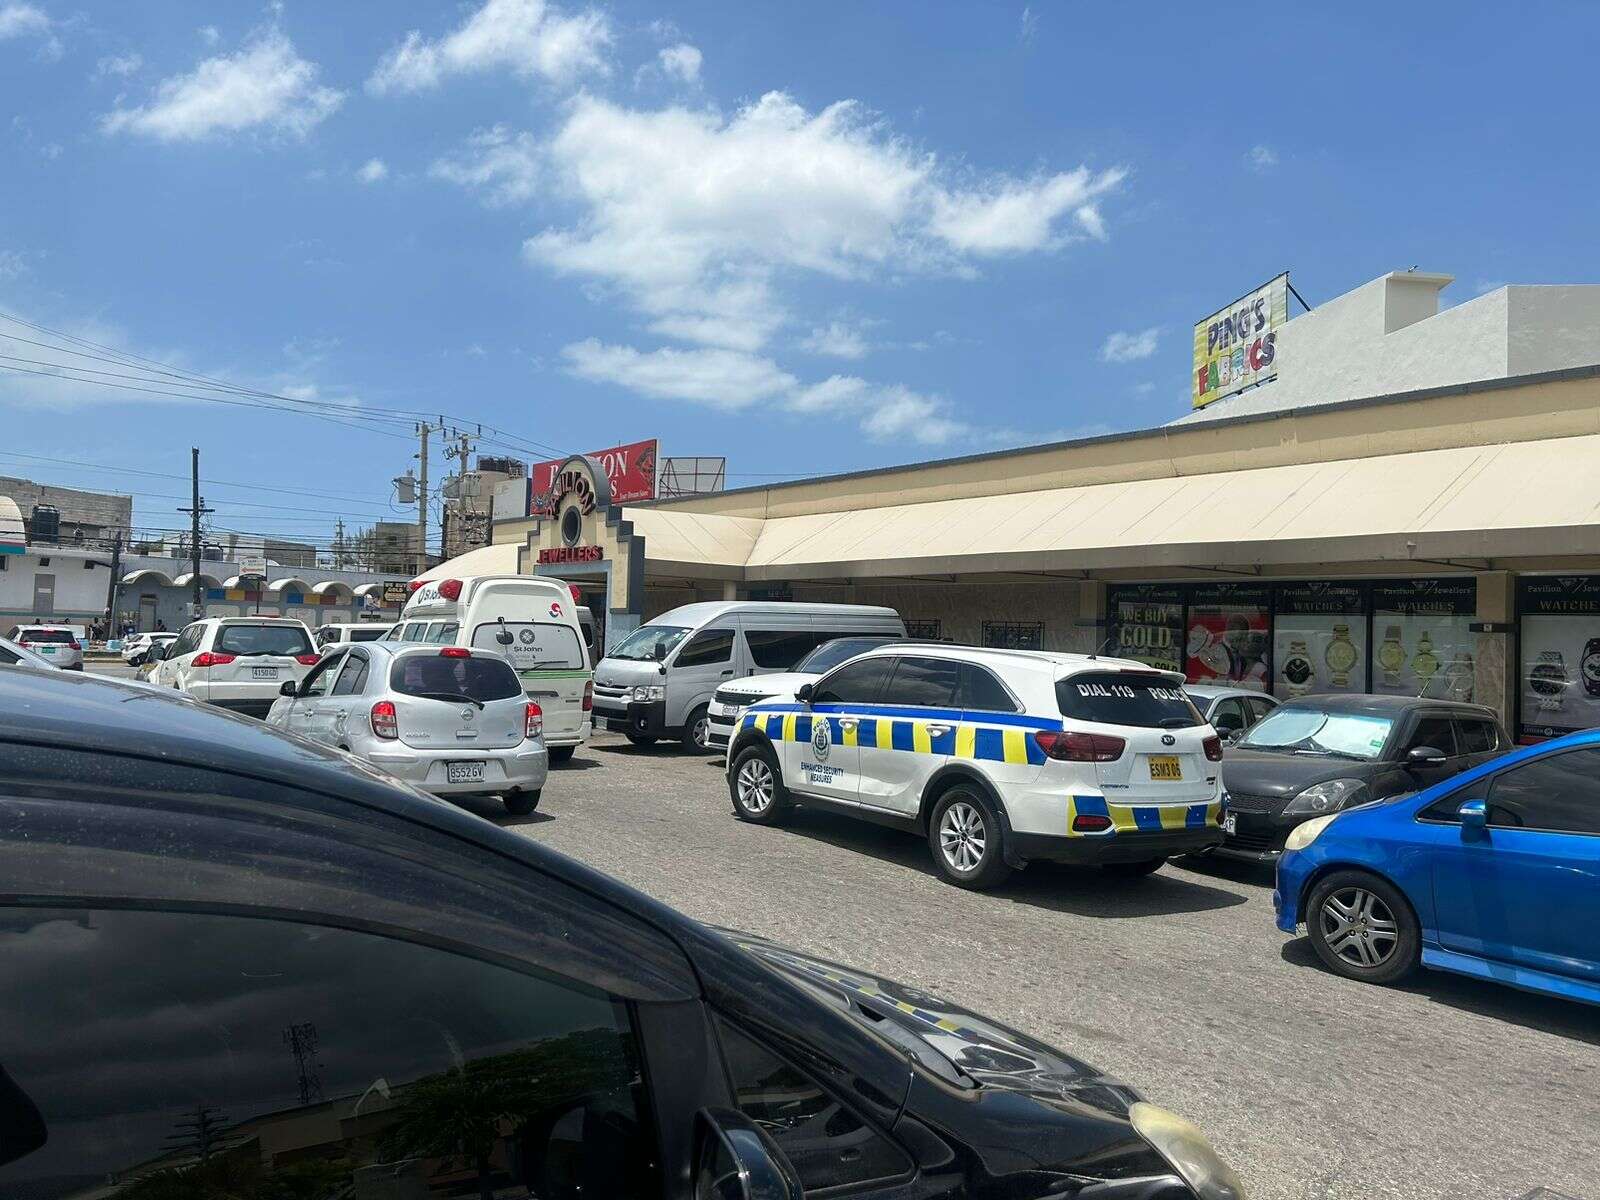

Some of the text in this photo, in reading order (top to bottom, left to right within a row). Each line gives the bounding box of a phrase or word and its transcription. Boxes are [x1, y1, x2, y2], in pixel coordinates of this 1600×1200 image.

[1198, 332, 1276, 396] FABRICS
[537, 545, 604, 564] JEWELLERS
[1527, 585, 1562, 593] Pavilion
[1397, 601, 1455, 611] WATCHES
[1123, 607, 1169, 623] WE BUY
[1120, 626, 1172, 649] GOLD
[1076, 684, 1111, 697] DIAL
[1111, 685, 1135, 698] 119
[450, 767, 471, 778] 8552
[801, 761, 844, 776] ENHANCED SECURITY
[810, 772, 832, 784] MEASURES
